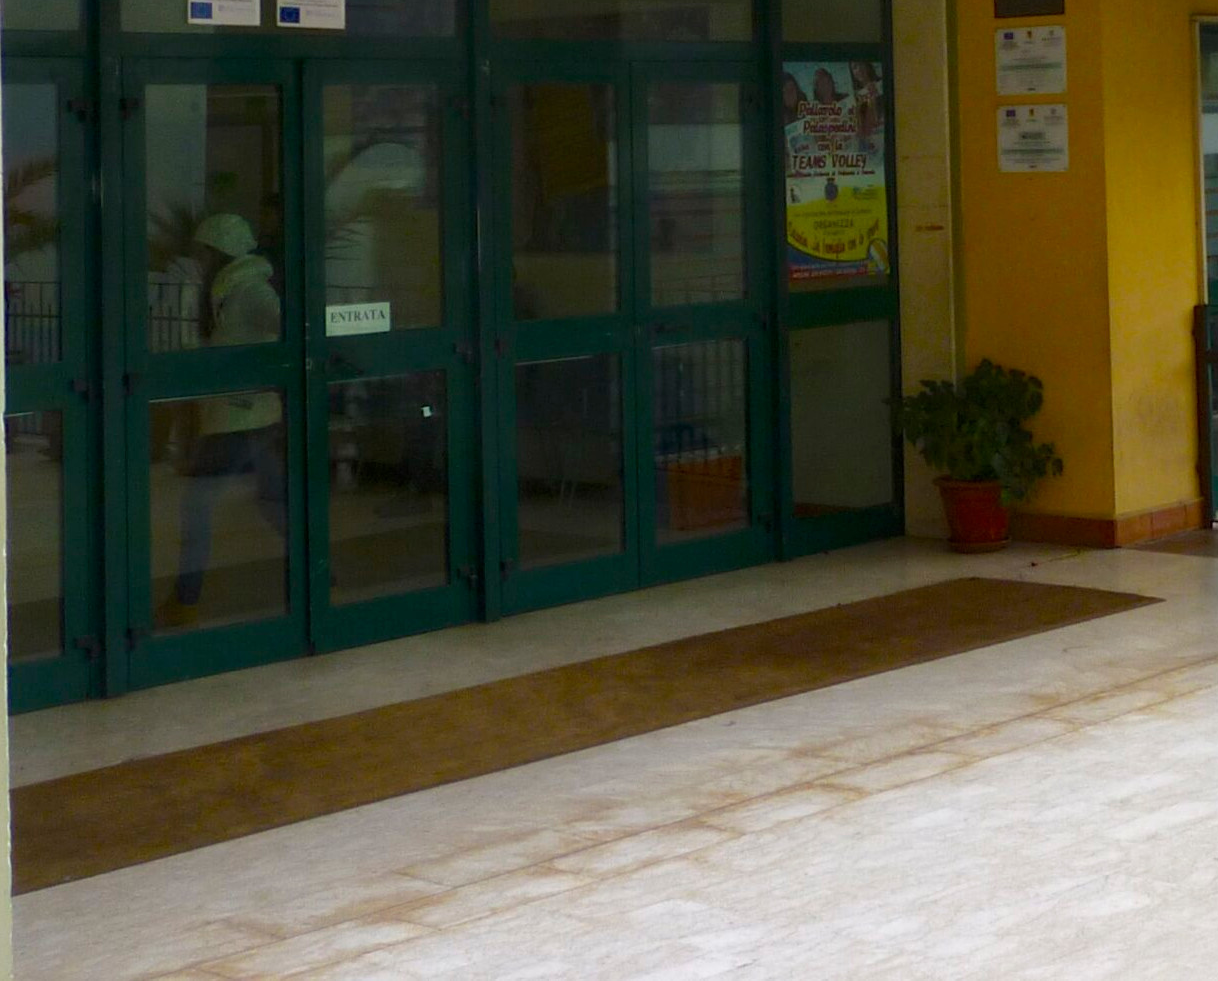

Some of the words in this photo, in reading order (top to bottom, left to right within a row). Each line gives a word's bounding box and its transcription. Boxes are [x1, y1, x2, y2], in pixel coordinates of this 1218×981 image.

[792, 154, 826, 169] TEAMS
[831, 153, 867, 169] VOLLEY
[331, 309, 386, 324] ENTRATA
